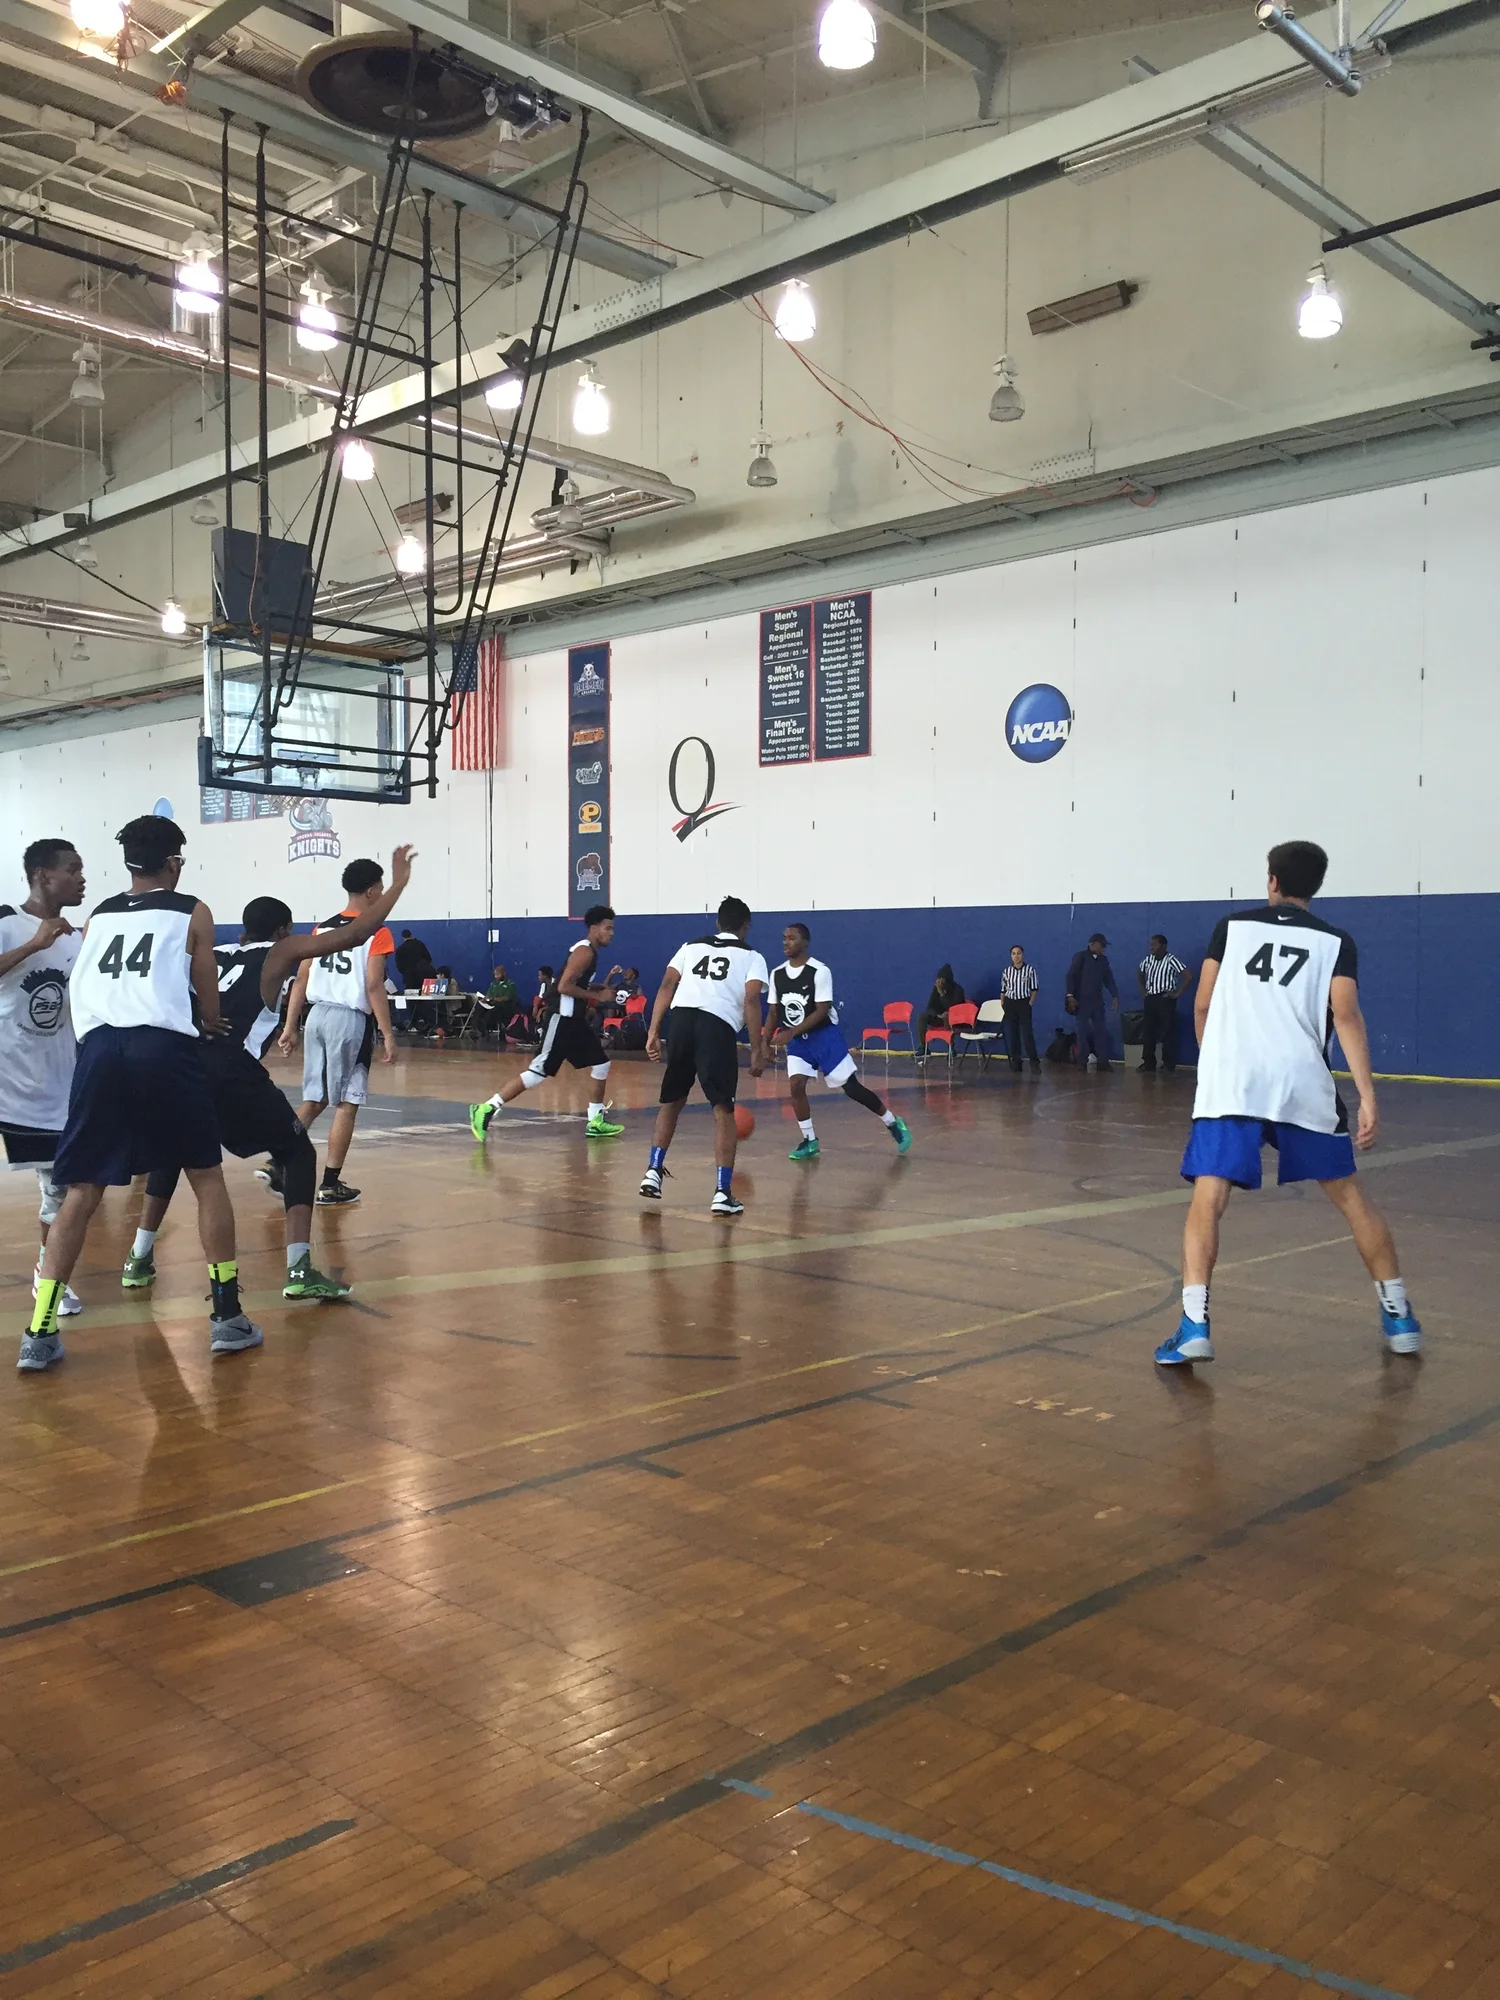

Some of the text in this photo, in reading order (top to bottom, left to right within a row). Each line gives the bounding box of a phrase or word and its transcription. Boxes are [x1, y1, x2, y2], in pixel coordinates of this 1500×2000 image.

[830, 600, 855, 611] Men's
[774, 610, 797, 621] Men's
[830, 609, 856, 621] NCAA
[774, 621, 798, 631] Super
[823, 620, 848, 630] Regional
[769, 629, 804, 642] Regional
[823, 630, 846, 638] Baseball
[769, 641, 803, 651] Appearances
[823, 638, 846, 646] Baseball
[823, 646, 846, 655] Baseball
[820, 654, 848, 663] Basketball
[774, 664, 797, 674] Men's
[820, 662, 848, 671] Basketball
[767, 670, 804, 683] Sweet 16
[769, 681, 803, 691] Appearances
[821, 694, 848, 703] Basketball
[774, 719, 797, 729] Men's
[766, 727, 805, 738] Final Four
[1011, 720, 1069, 746] NCAA
[768, 736, 802, 745] Appearances
[668, 736, 744, 843] Q
[582, 804, 600, 822] P
[290, 838, 340, 860] KNIGHTS
[98, 932, 154, 980] 44
[318, 949, 352, 974] 45
[692, 955, 730, 981] 43
[1244, 942, 1310, 988] 47
